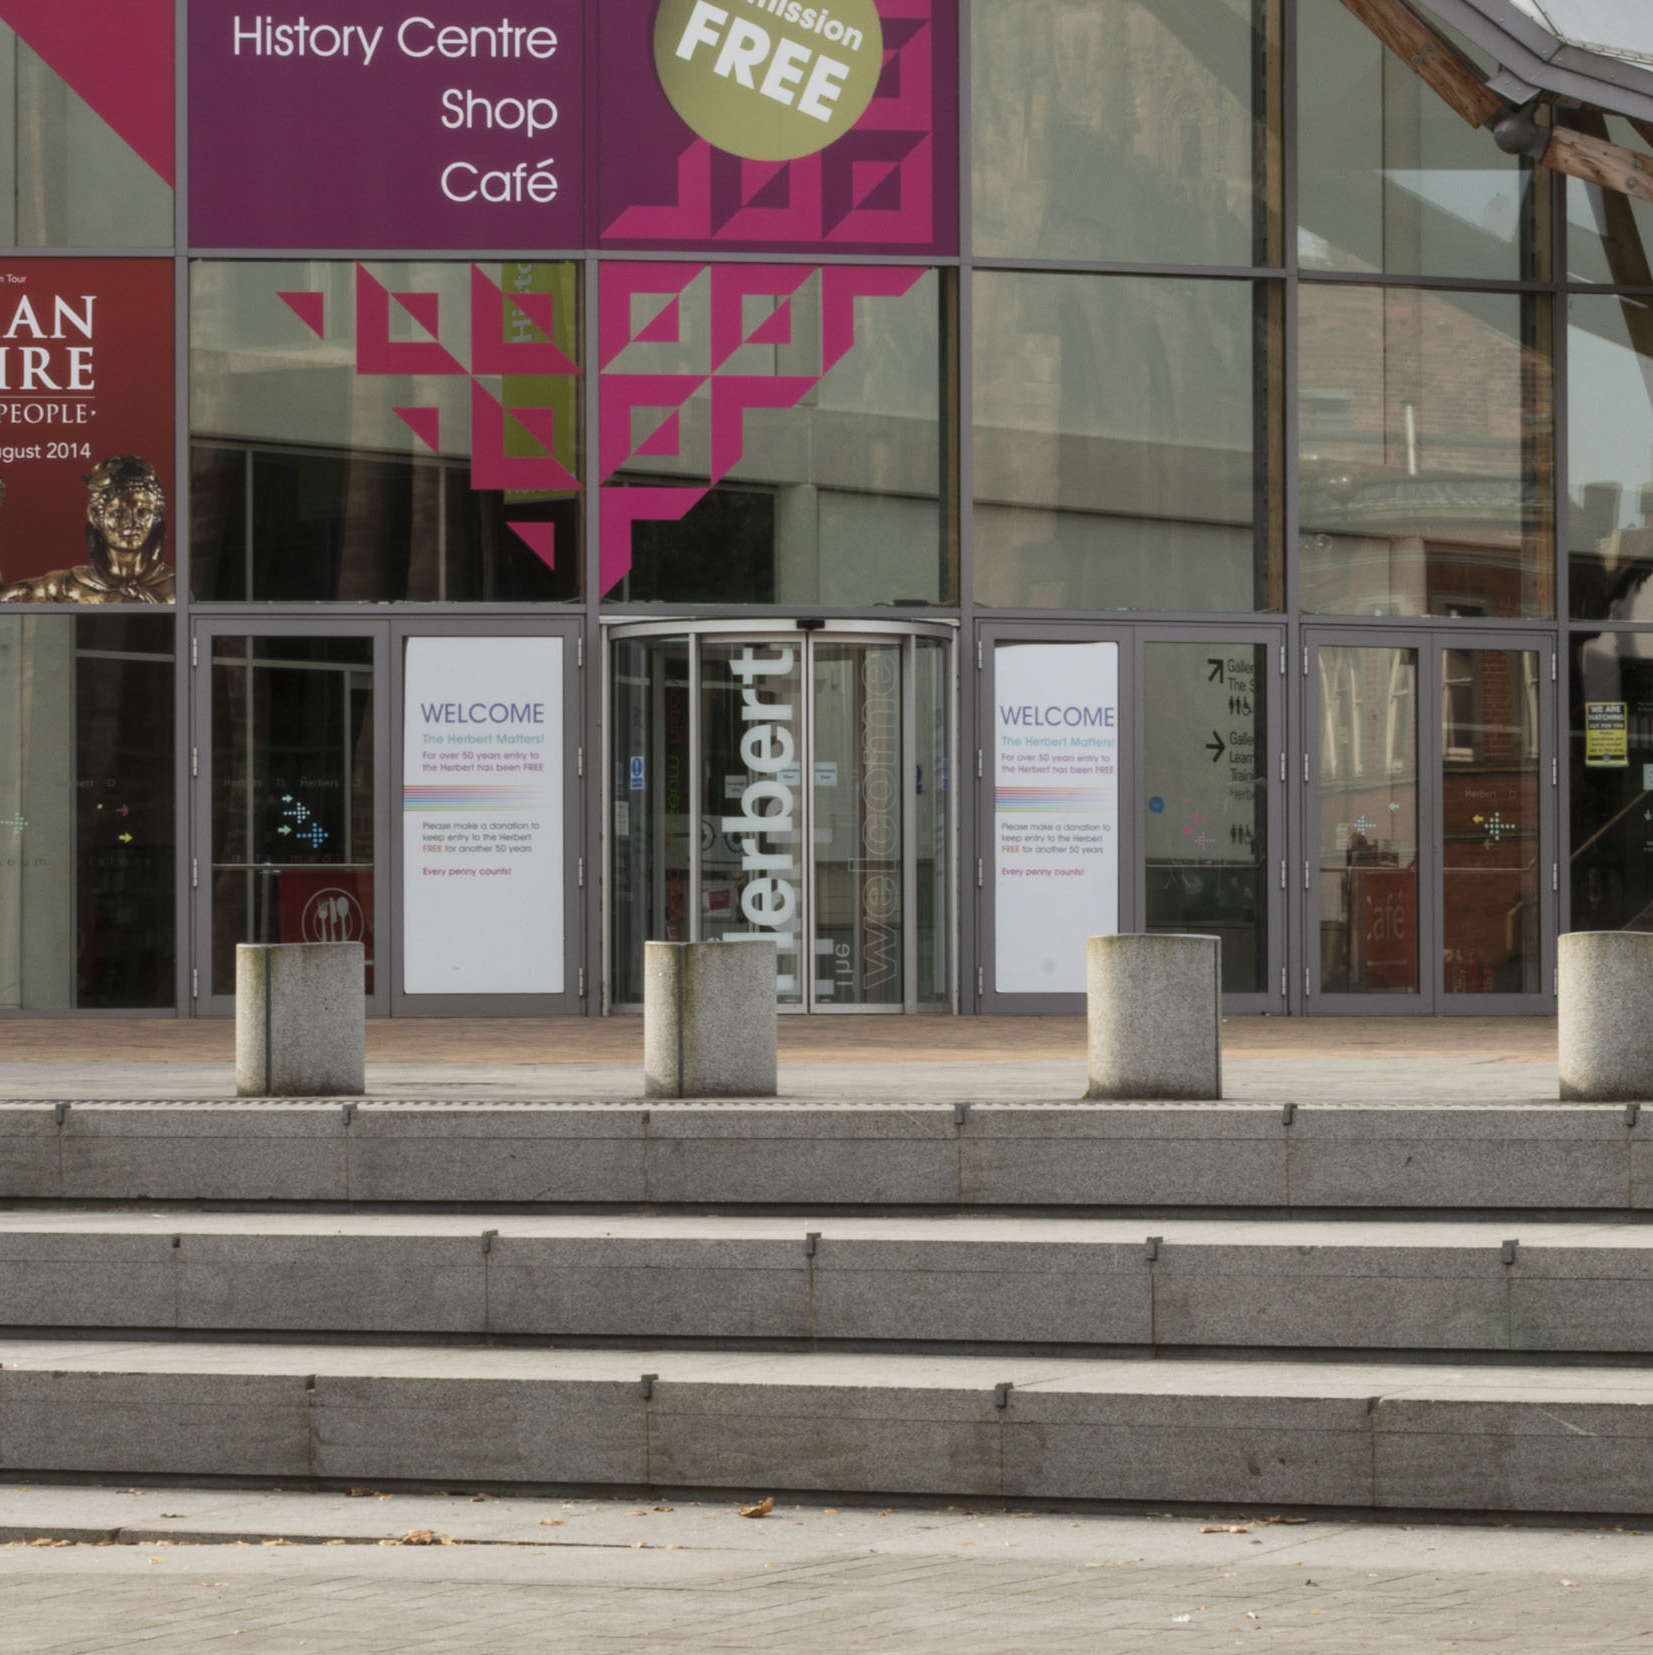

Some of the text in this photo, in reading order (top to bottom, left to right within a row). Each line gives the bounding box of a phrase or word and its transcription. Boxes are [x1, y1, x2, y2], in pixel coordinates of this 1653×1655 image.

[232, 16, 558, 65] History Centre
[674, 0, 851, 122] FREE
[441, 90, 558, 137] Shop
[441, 158, 558, 203] Café
[6, 274, 27, 283] Tour
[47, 442, 91, 459] 2014
[1227, 677, 1246, 692] The
[420, 703, 545, 724] WELCOME
[1000, 705, 1115, 727] WELCOME
[423, 733, 545, 745] The Herbert Matters!
[1002, 736, 1115, 748] The Herbert Matters!
[422, 751, 436, 760] For
[461, 751, 474, 760] 50
[476, 753, 500, 762] years
[503, 752, 527, 762] entry
[530, 751, 540, 760] to
[1001, 753, 1014, 761] For
[1038, 753, 1050, 762] 50
[1052, 754, 1074, 763] years
[1077, 754, 1099, 763] entry
[1101, 754, 1110, 762] to
[422, 763, 544, 772] the Herbert has been FREE
[1002, 765, 1114, 775] the Herbert has been FREE
[422, 821, 451, 830] Please
[453, 822, 477, 830] make
[489, 821, 529, 830] donation
[532, 822, 540, 830] to
[848, 653, 898, 990] welcome
[1001, 822, 1028, 831] Please
[1063, 823, 1100, 831] donation
[1102, 824, 1111, 832] to
[422, 833, 532, 843] keep entry to the Herbert
[1002, 834, 1103, 844] keep entry to the Herbert
[422, 844, 532, 855] FREE for another 50 years
[1002, 845, 1104, 855] FREE for another 50 years
[422, 867, 511, 877] Every penny counts!
[1002, 867, 1084, 877] Every penny counts!
